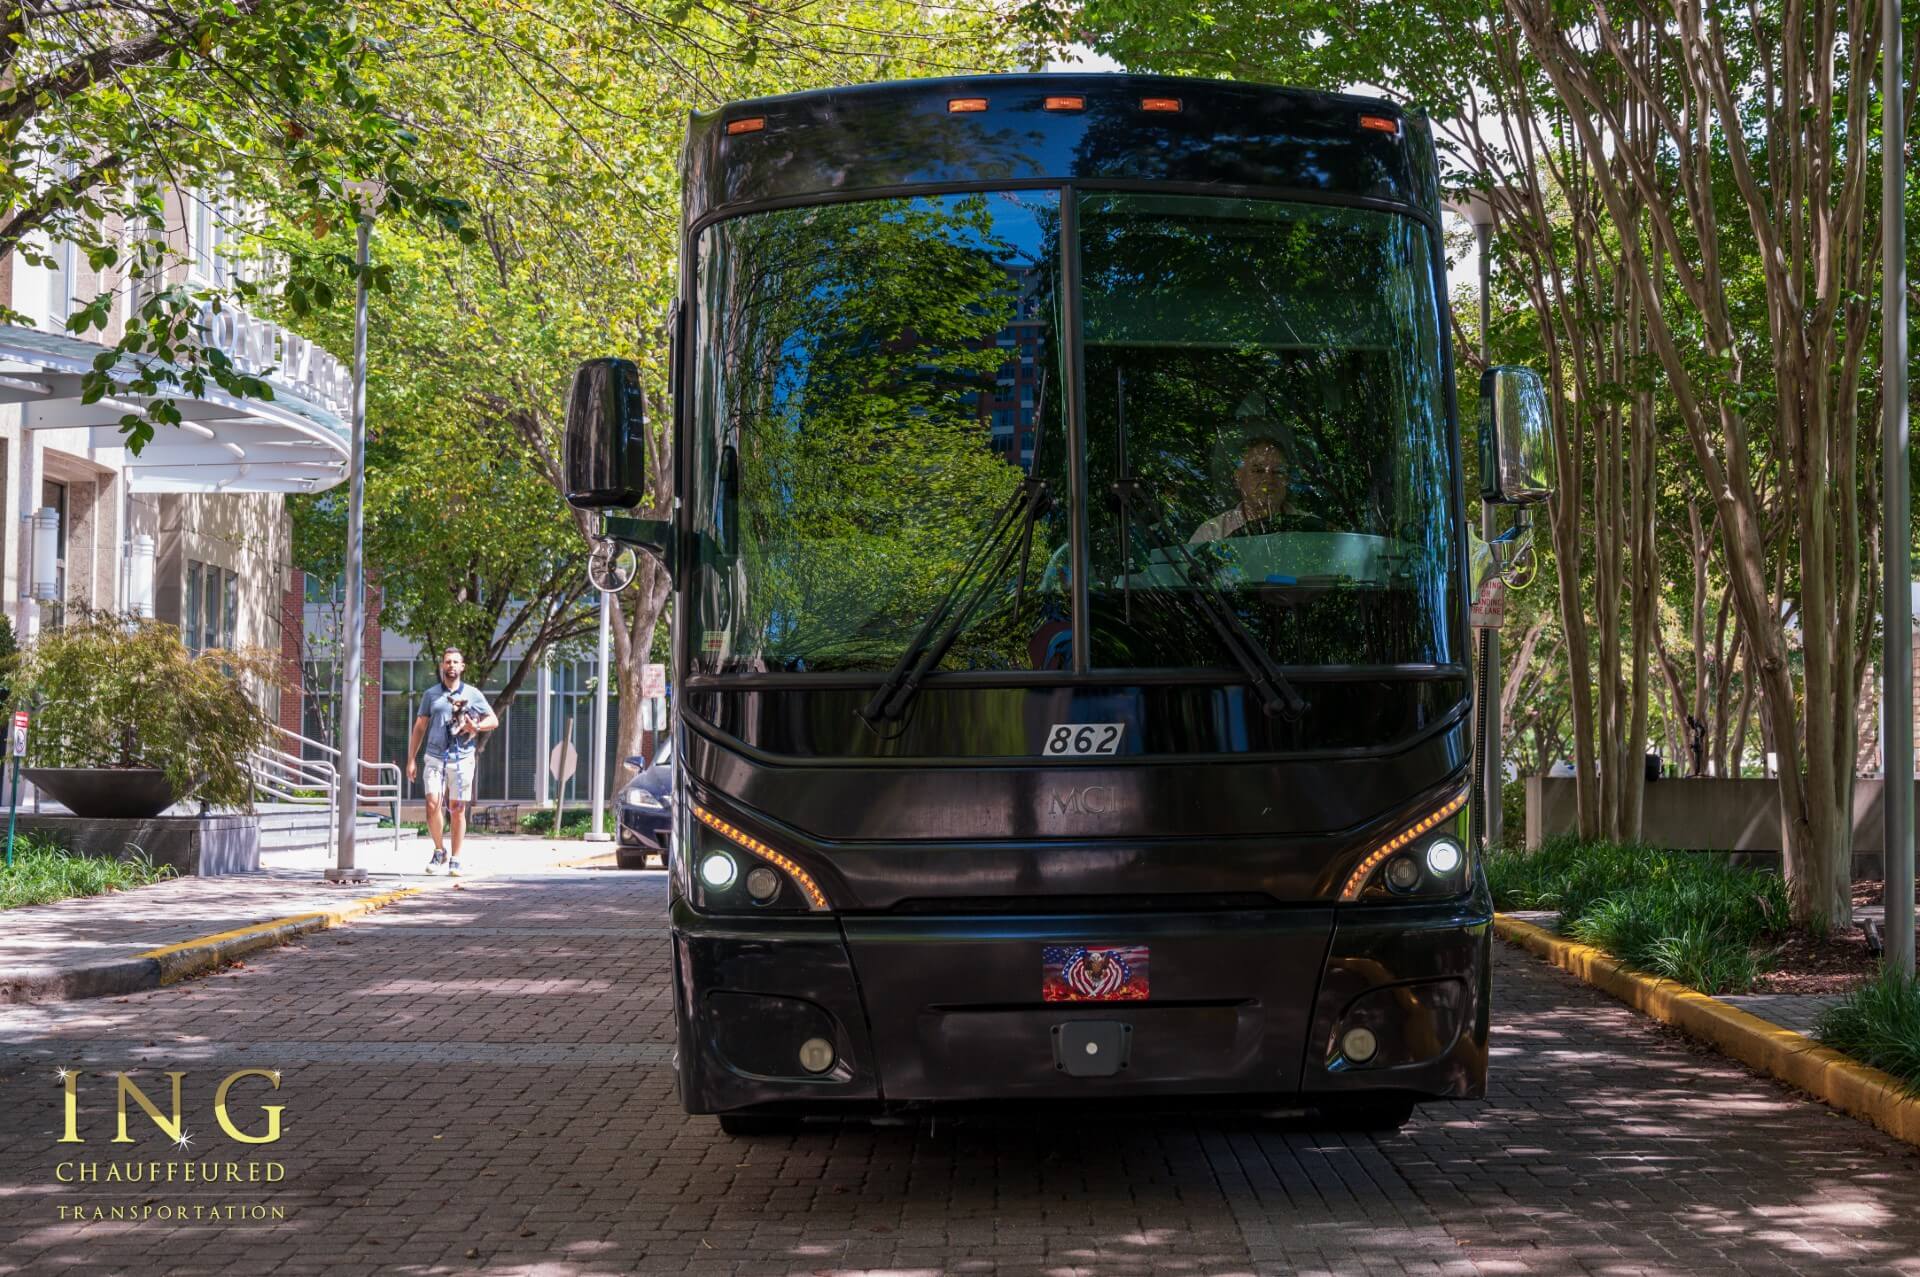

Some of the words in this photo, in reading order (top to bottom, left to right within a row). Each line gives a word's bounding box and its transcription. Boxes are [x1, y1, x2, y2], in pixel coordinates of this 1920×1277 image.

[1485, 607, 1501, 615] LANE
[1050, 726, 1118, 754] 862
[1049, 785, 1121, 815] MCI
